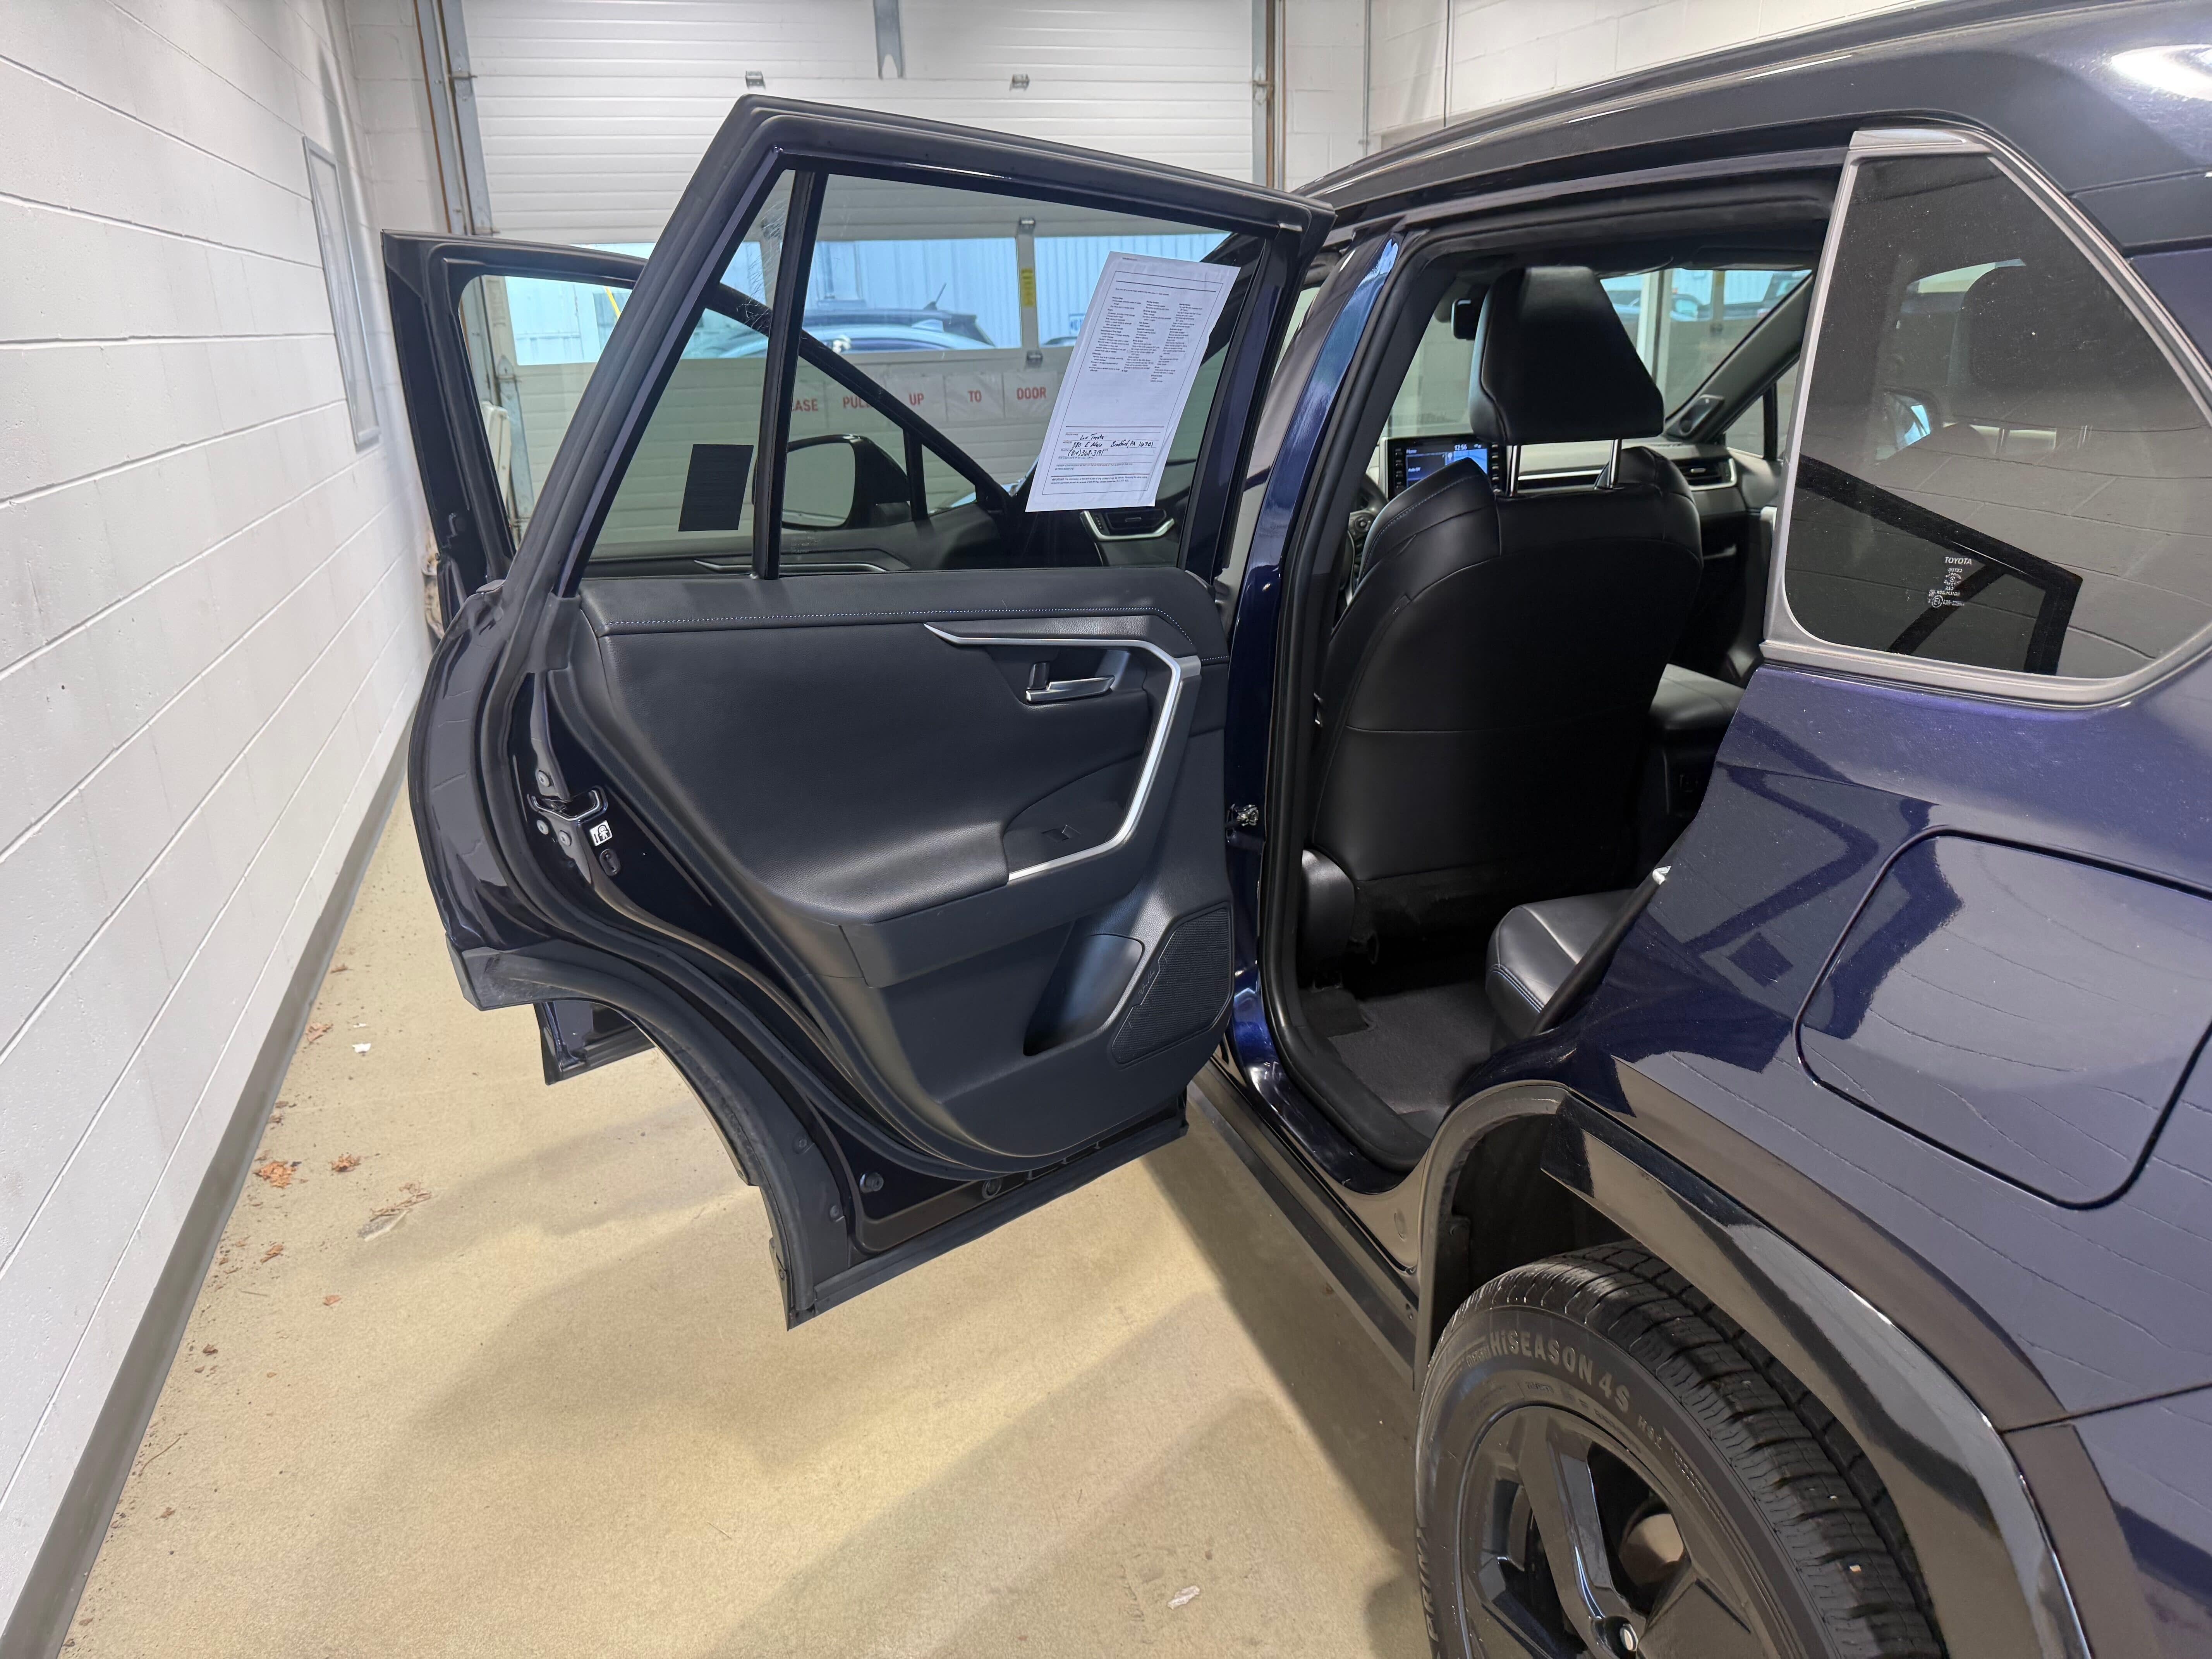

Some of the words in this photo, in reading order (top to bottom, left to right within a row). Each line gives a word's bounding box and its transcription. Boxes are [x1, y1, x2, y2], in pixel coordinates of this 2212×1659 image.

[792, 398, 818, 412] ASE
[843, 395, 870, 409] PUL
[909, 393, 924, 406] UP
[968, 390, 982, 403] TO
[1017, 387, 1046, 400] DOOR
[1945, 556, 1972, 565] TOYOTA
